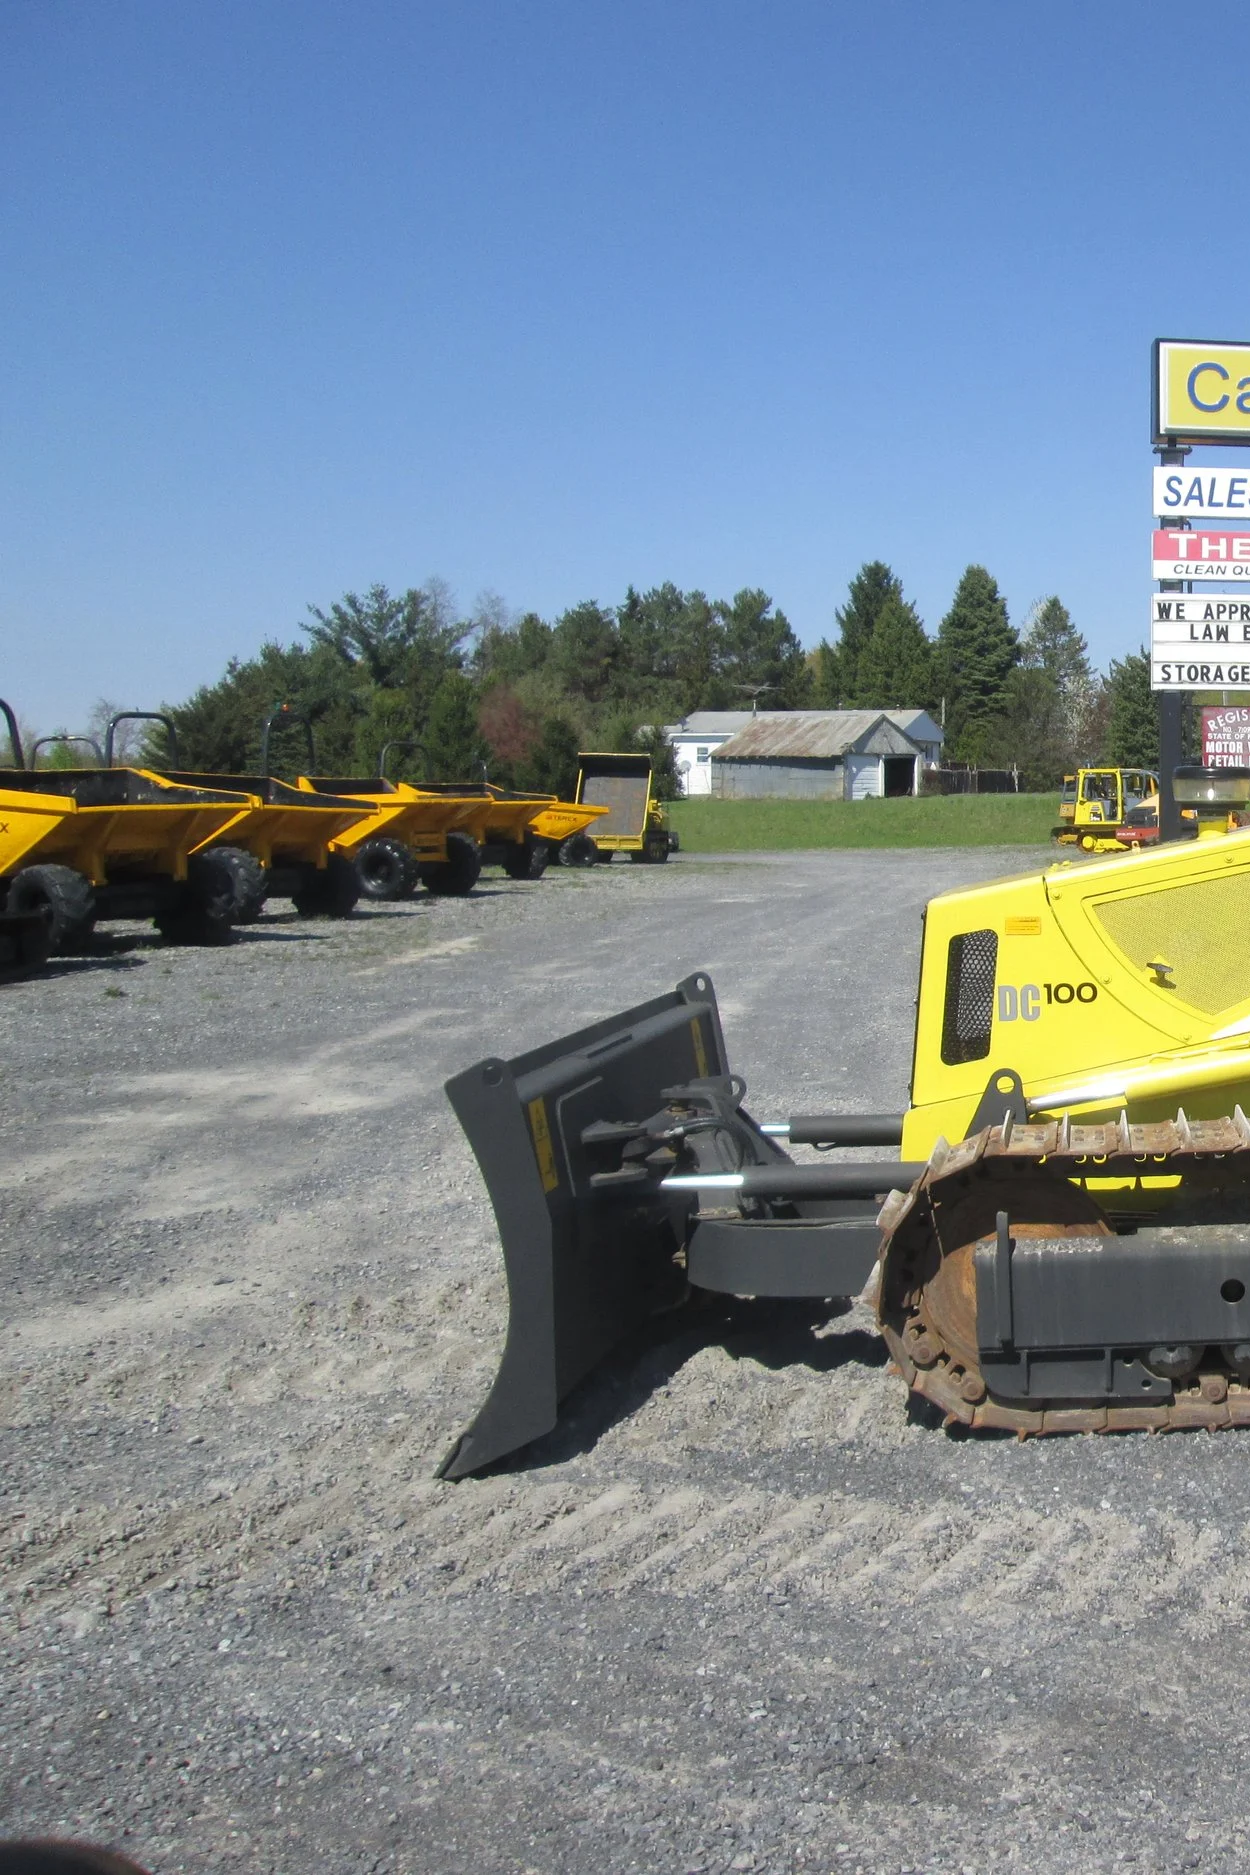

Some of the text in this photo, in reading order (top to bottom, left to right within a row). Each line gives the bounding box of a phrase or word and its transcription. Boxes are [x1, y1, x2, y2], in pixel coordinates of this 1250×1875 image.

[1173, 564, 1227, 575] CLEAN
[1157, 602, 1185, 620] WE
[1190, 624, 1229, 643] LAW
[1161, 664, 1250, 683] STORAGE
[1205, 741, 1244, 753] MOTOR
[1208, 755, 1245, 767] RETAIL
